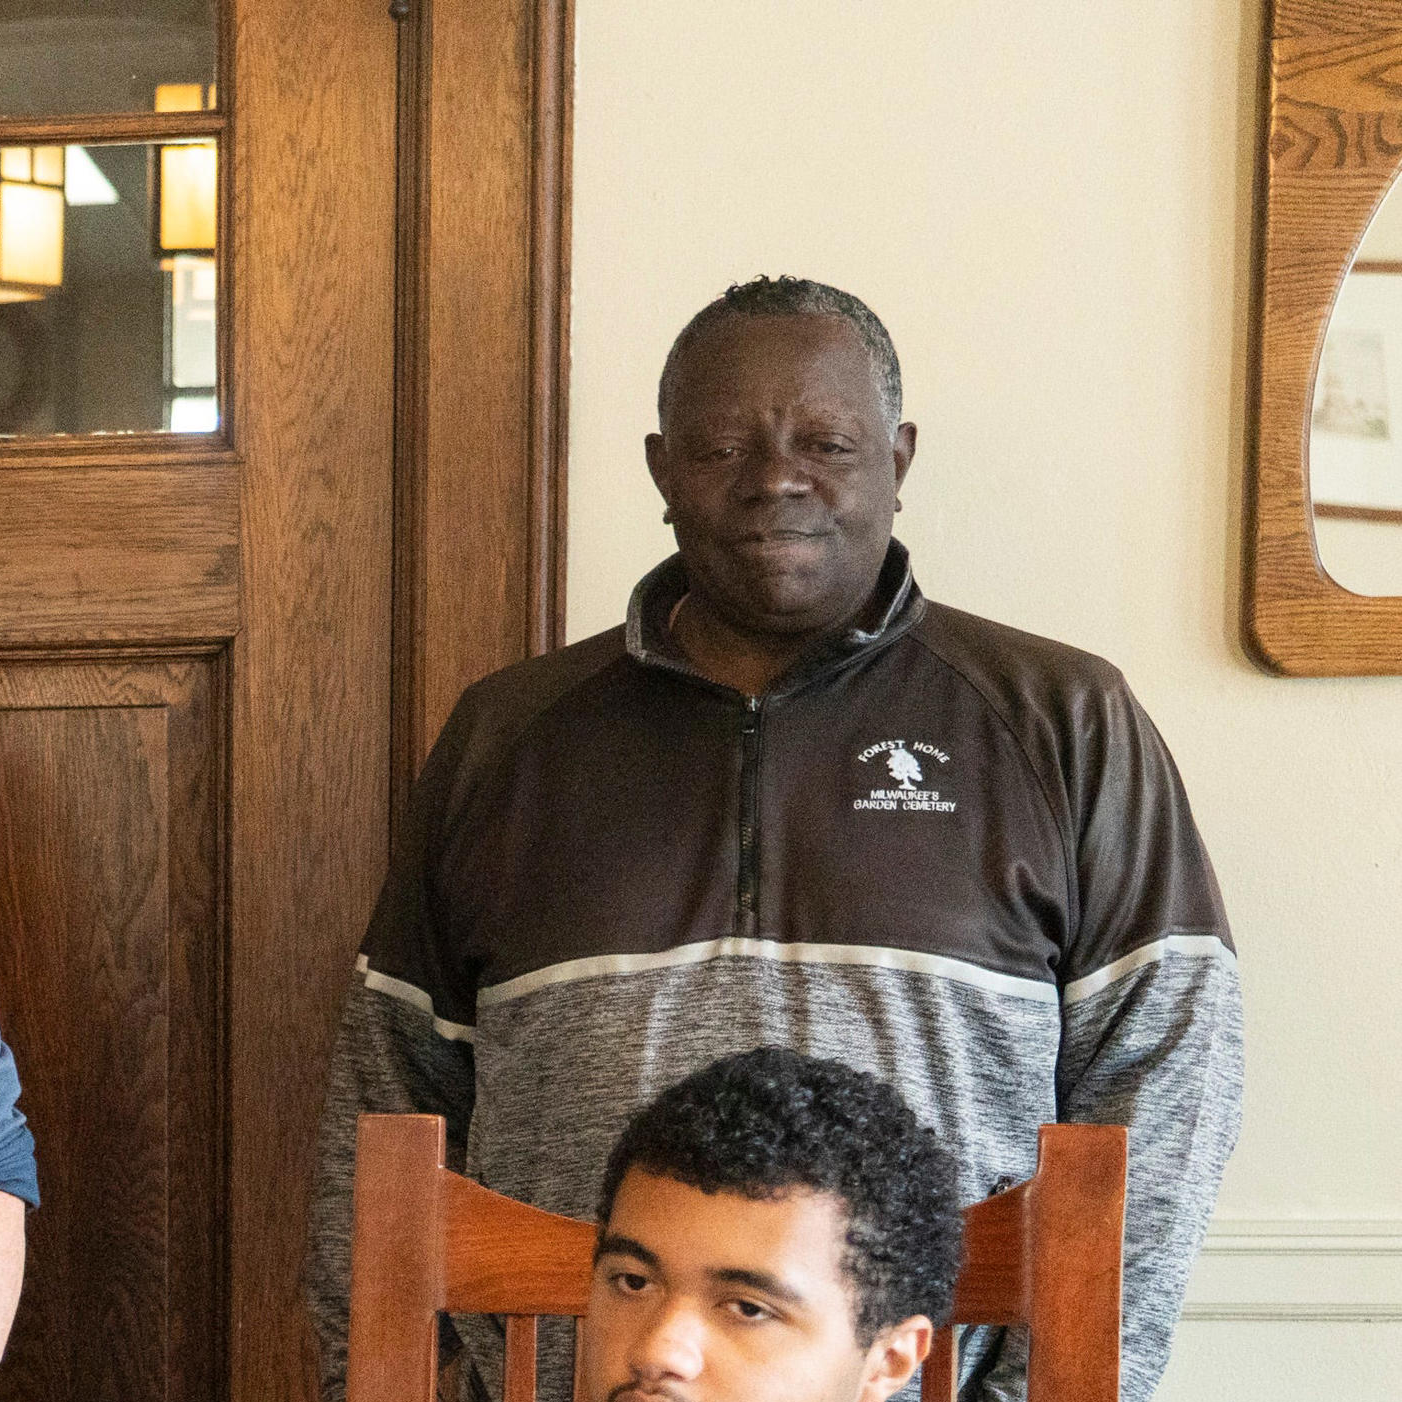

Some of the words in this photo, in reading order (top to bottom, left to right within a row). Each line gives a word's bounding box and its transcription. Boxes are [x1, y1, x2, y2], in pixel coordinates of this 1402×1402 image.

[857, 739, 907, 763] FOREST
[912, 740, 951, 764] HOME
[870, 789, 940, 801] MILWAUKEE'S
[853, 799, 898, 810] GARDEN
[902, 800, 957, 813] CEMETERY
